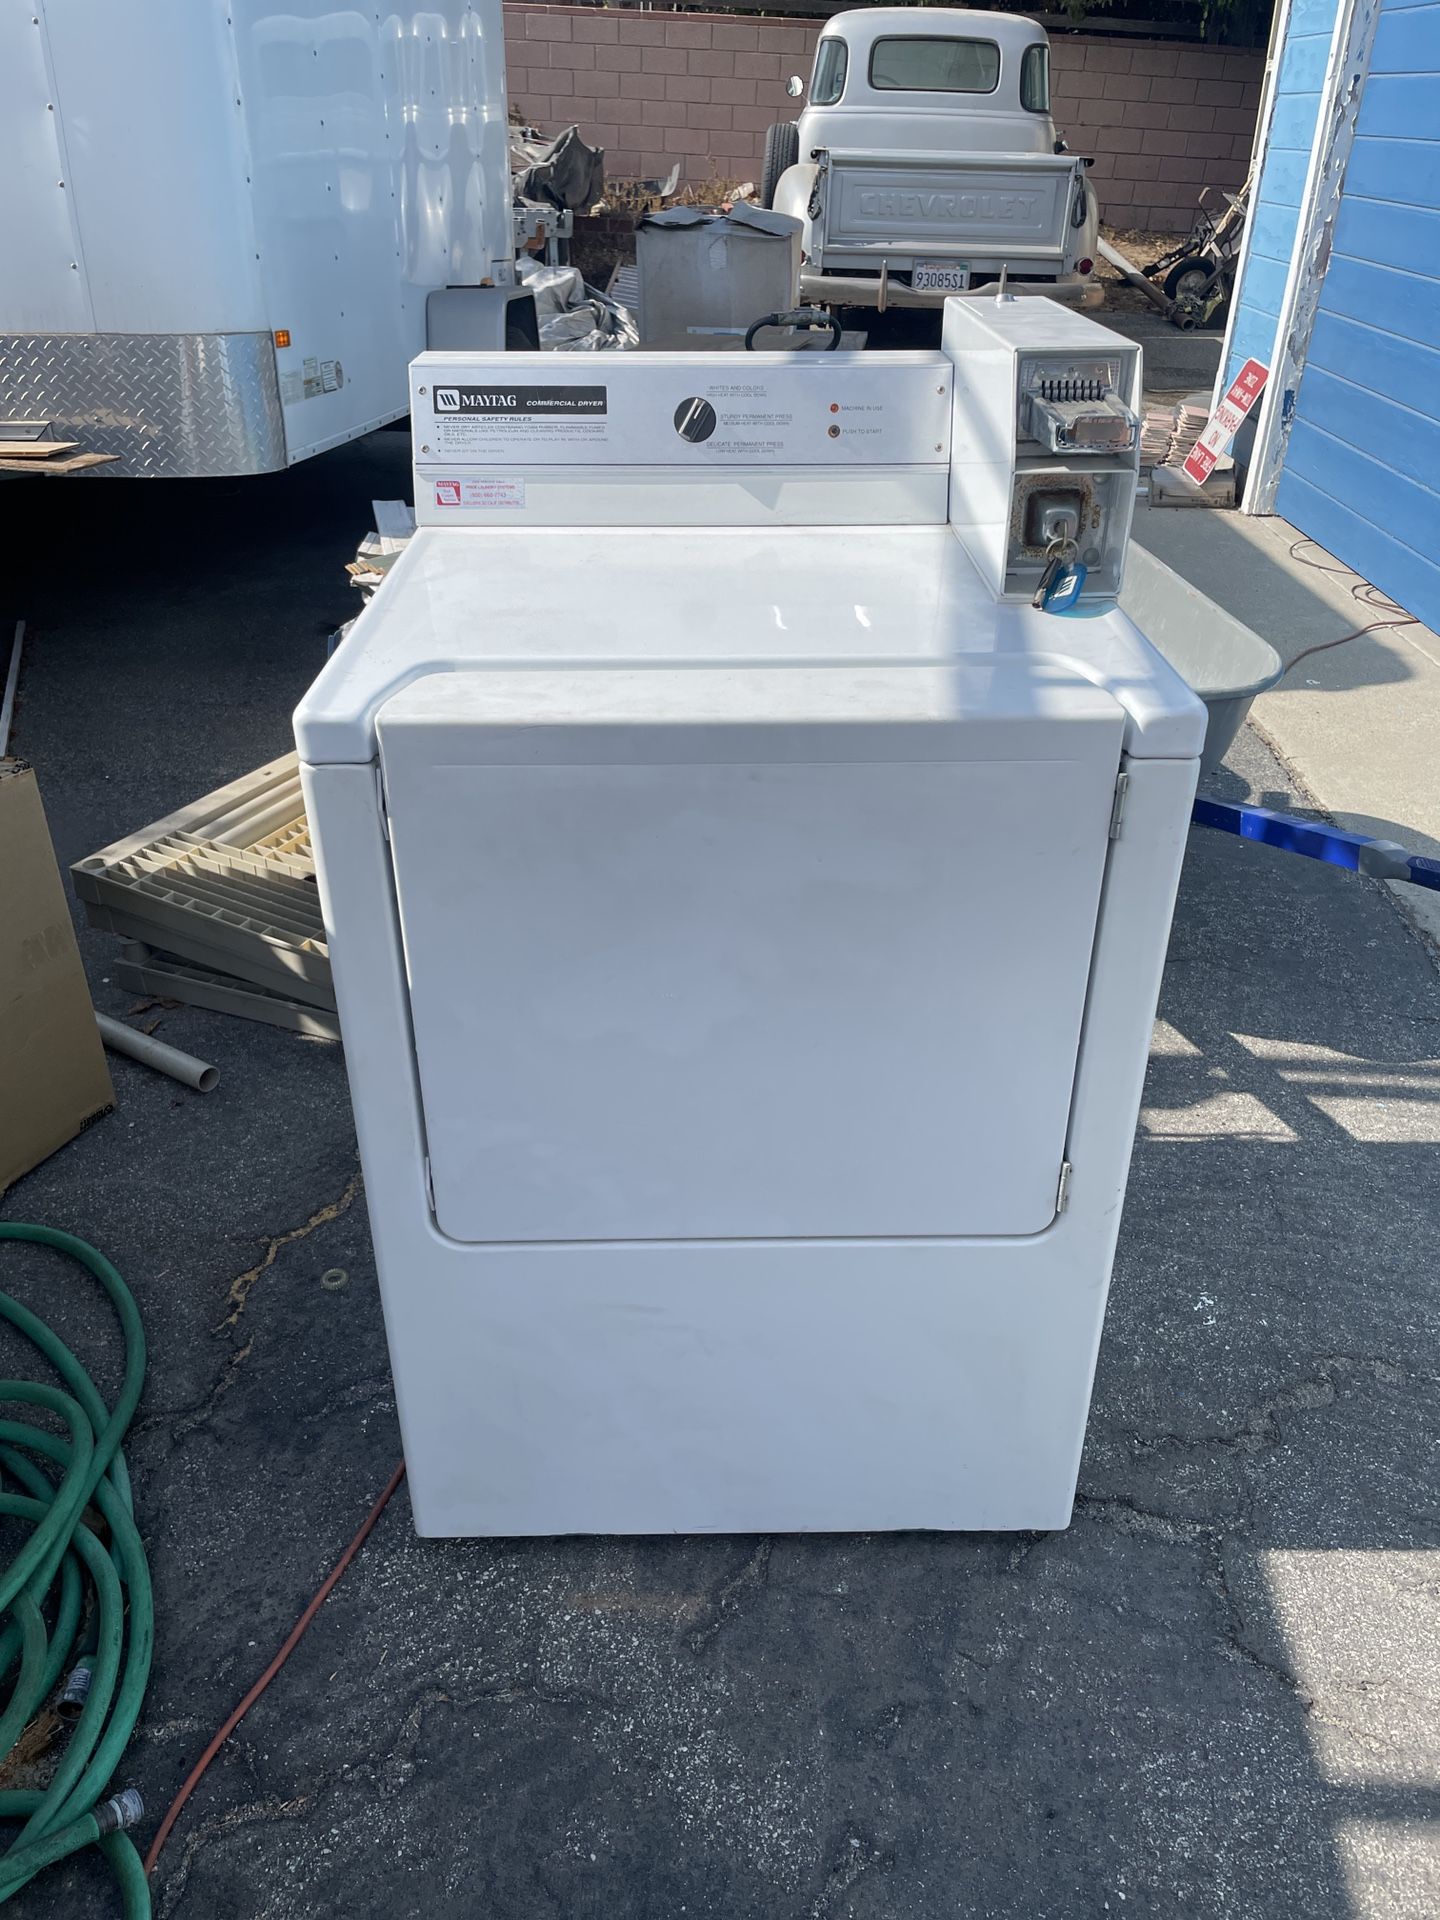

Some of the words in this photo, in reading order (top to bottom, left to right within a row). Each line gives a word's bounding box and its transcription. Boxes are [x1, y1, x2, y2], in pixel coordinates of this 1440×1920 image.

[859, 191, 1037, 220] CHEVROLET
[915, 271, 964, 289] 93085S1
[461, 394, 517, 407] MAYTAG
[1214, 404, 1241, 433] PARKING
[1207, 430, 1221, 447] NO
[1190, 446, 1204, 464] LANE
[1201, 455, 1213, 473] FIRE
